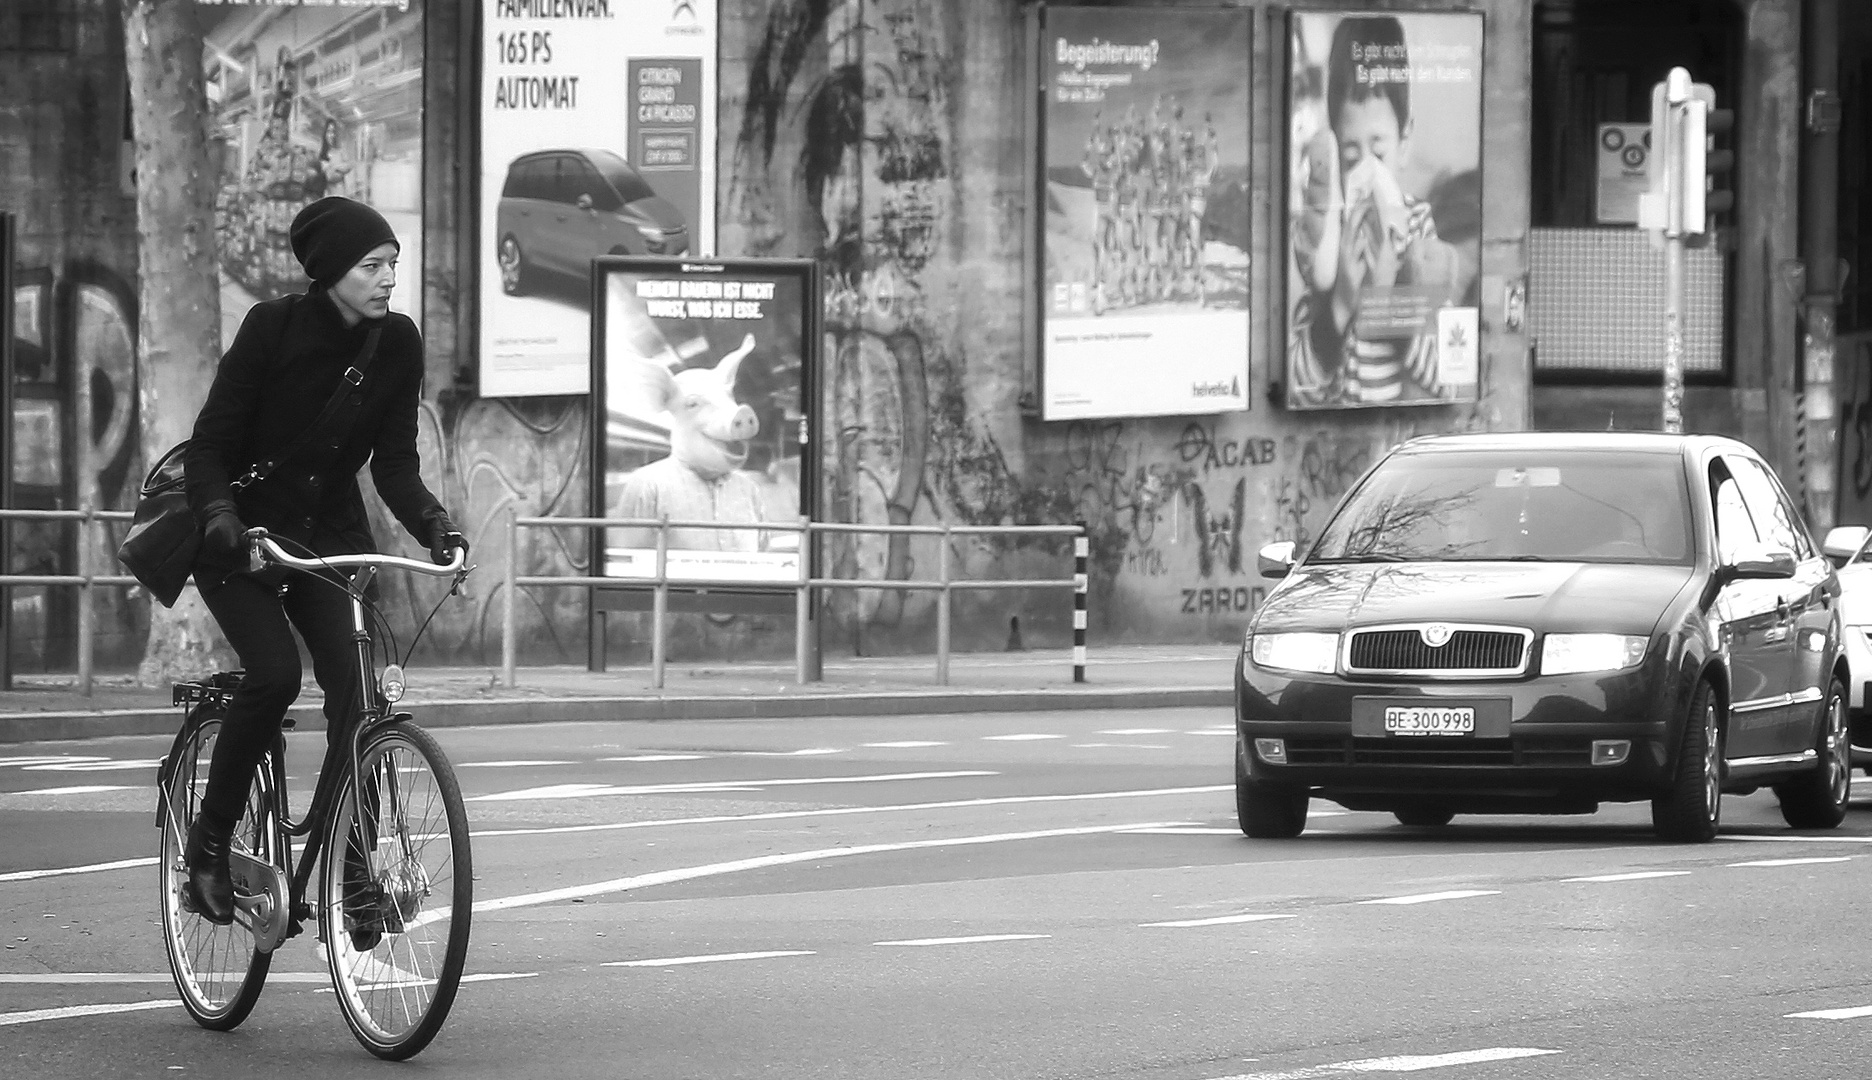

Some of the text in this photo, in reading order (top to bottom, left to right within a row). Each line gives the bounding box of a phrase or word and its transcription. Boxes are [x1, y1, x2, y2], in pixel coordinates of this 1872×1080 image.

[498, 32, 552, 63] 165 PS
[1057, 37, 1159, 71] Begeisterung?
[495, 76, 579, 108] AUTOMAT
[723, 281, 742, 299] IST
[741, 282, 776, 300] NICHT
[687, 301, 713, 319] WAS
[713, 301, 733, 319] ICH
[1204, 438, 1276, 473] ACAB
